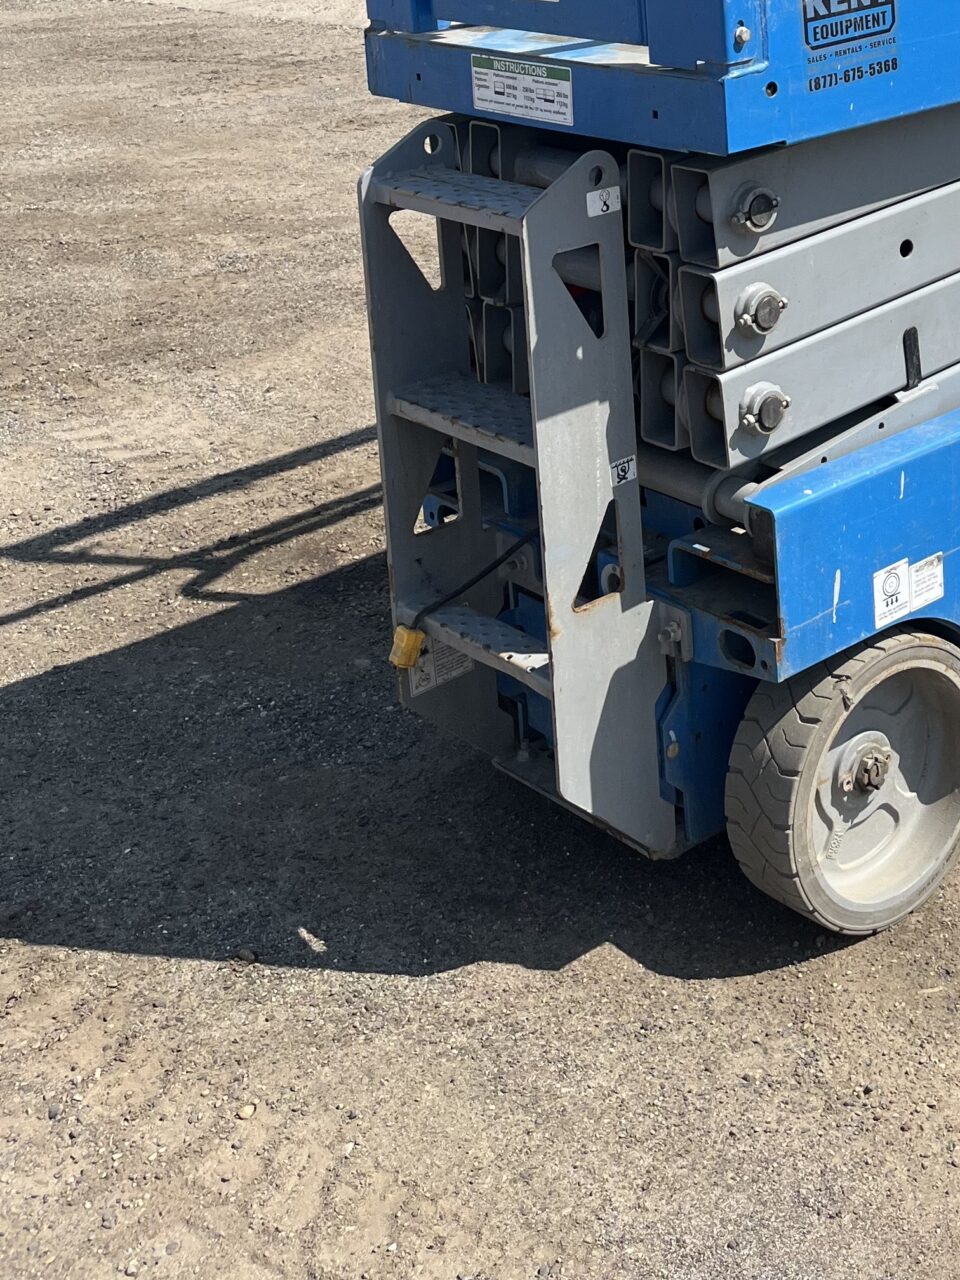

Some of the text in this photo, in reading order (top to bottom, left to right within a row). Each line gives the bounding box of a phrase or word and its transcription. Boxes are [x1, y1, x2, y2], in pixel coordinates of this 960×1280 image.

[812, 10, 888, 42] EQUIPMENT
[807, 36, 897, 65] SALES RENTALS SERVICE
[493, 60, 547, 77] INSTRUCTIONS
[808, 57, 898, 92] (877)-675-5368
